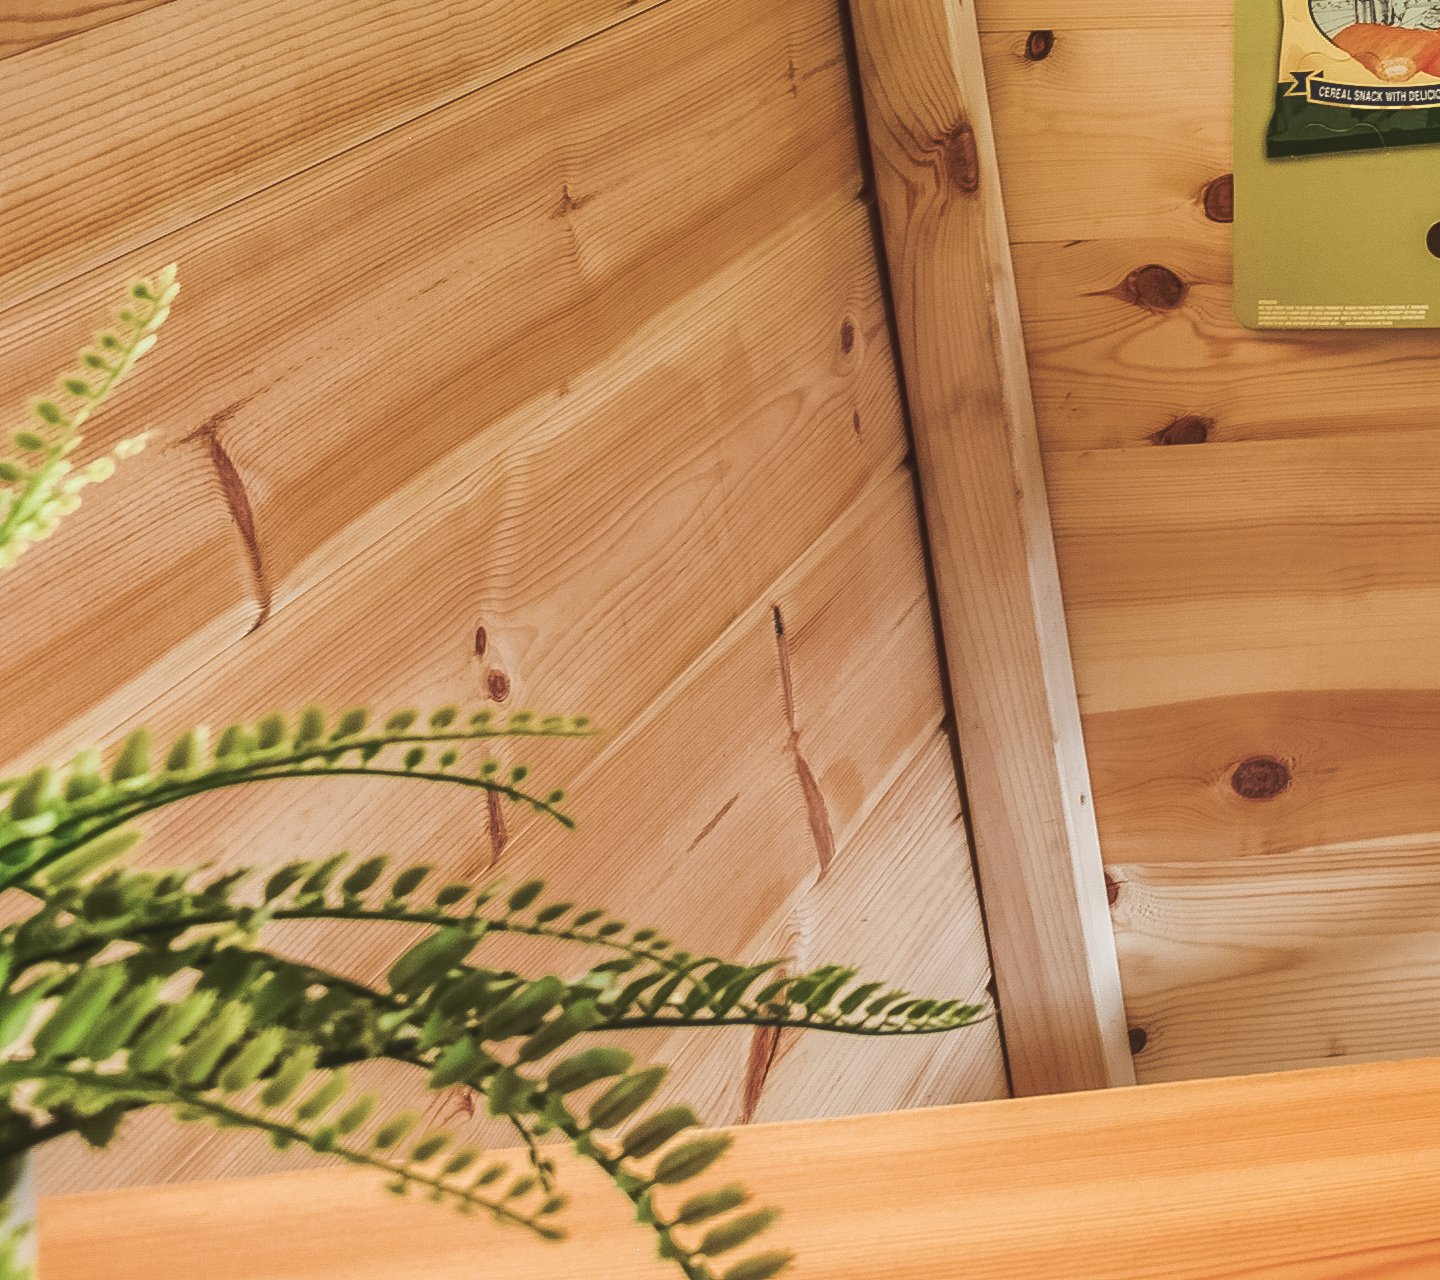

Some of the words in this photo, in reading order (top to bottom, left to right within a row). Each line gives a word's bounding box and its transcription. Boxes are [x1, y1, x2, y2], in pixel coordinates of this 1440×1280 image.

[1318, 86, 1352, 100] CEREAL
[1353, 90, 1383, 102] SNACK
[1385, 90, 1407, 102] WITH
